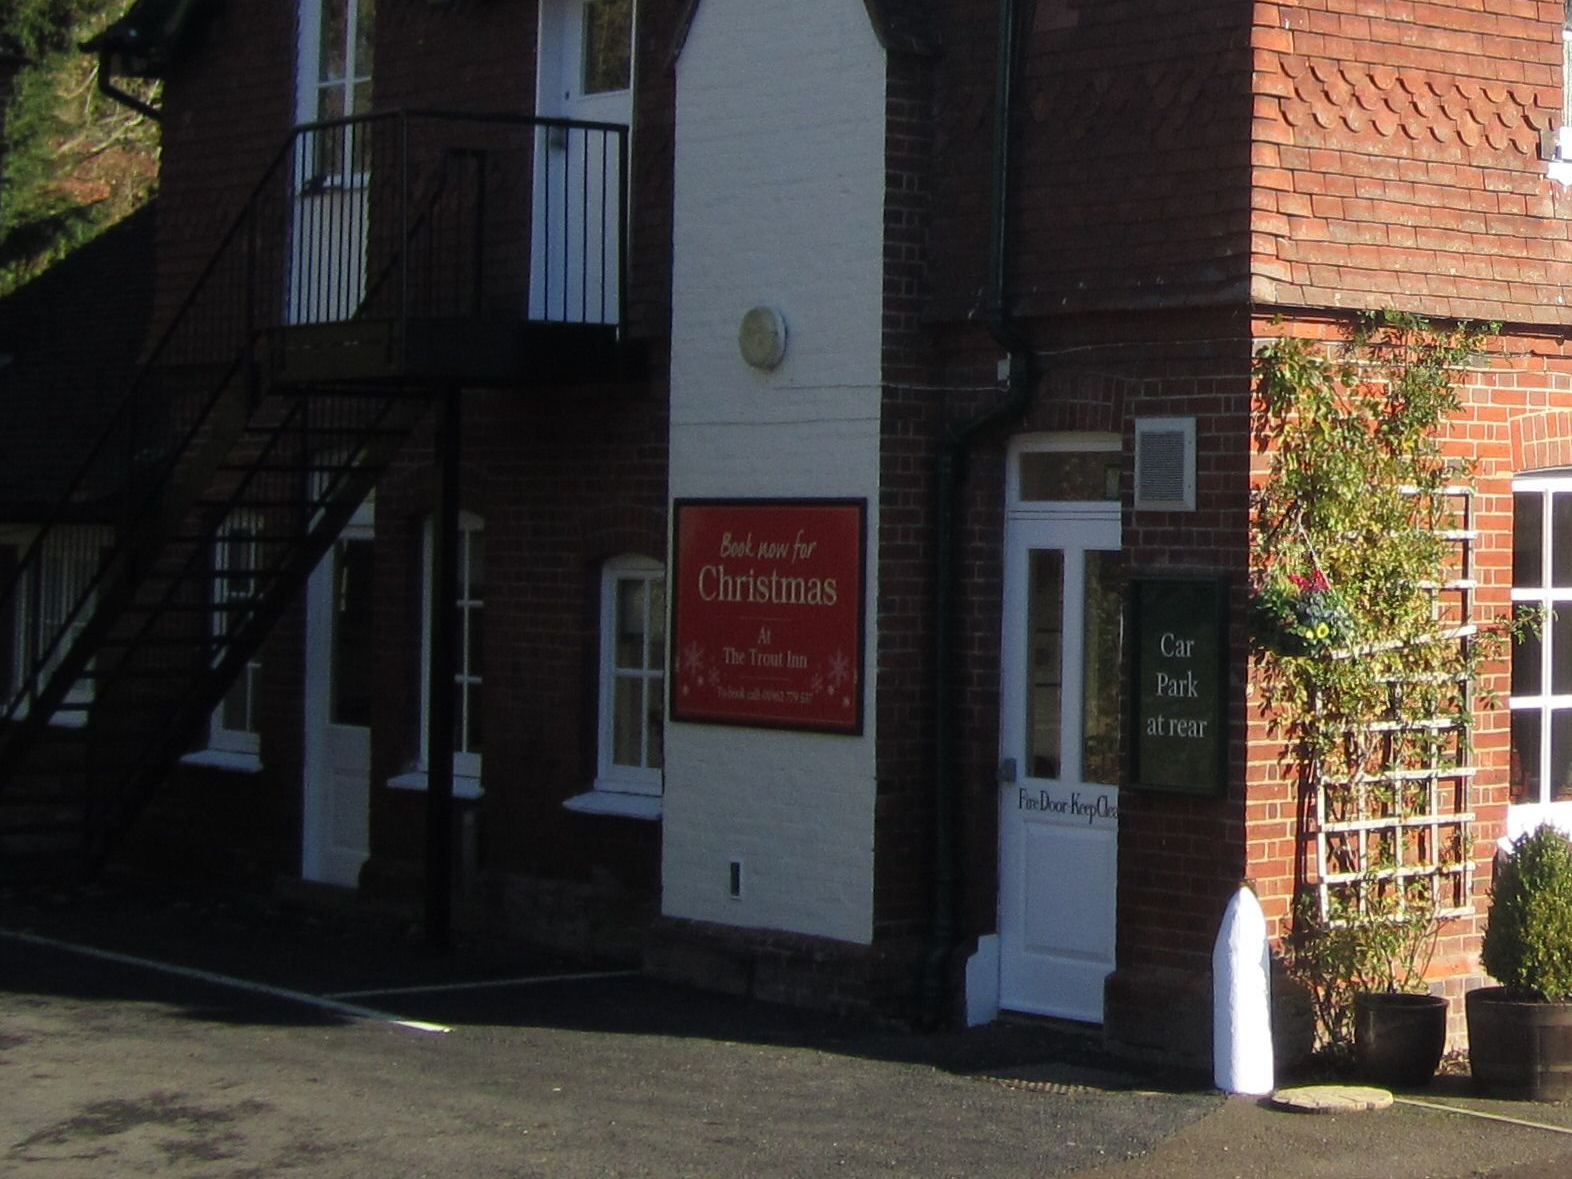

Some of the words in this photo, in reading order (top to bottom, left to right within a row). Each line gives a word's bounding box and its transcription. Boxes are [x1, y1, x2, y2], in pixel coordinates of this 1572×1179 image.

[720, 531, 754, 558] Book
[757, 541, 789, 559] now
[791, 529, 817, 563] for
[698, 565, 837, 606] Christmas
[758, 625, 771, 645] At
[1160, 632, 1195, 658] Car
[722, 646, 745, 665] The
[749, 648, 783, 668] Trout
[786, 650, 808, 669] Inn
[1156, 669, 1198, 697] Park
[1147, 714, 1165, 735] at
[1168, 718, 1208, 738] rear
[1018, 787, 1039, 810] Fire
[1040, 790, 1068, 813] Door
[1070, 792, 1097, 825] Keep
[1097, 795, 1119, 819] Clea
